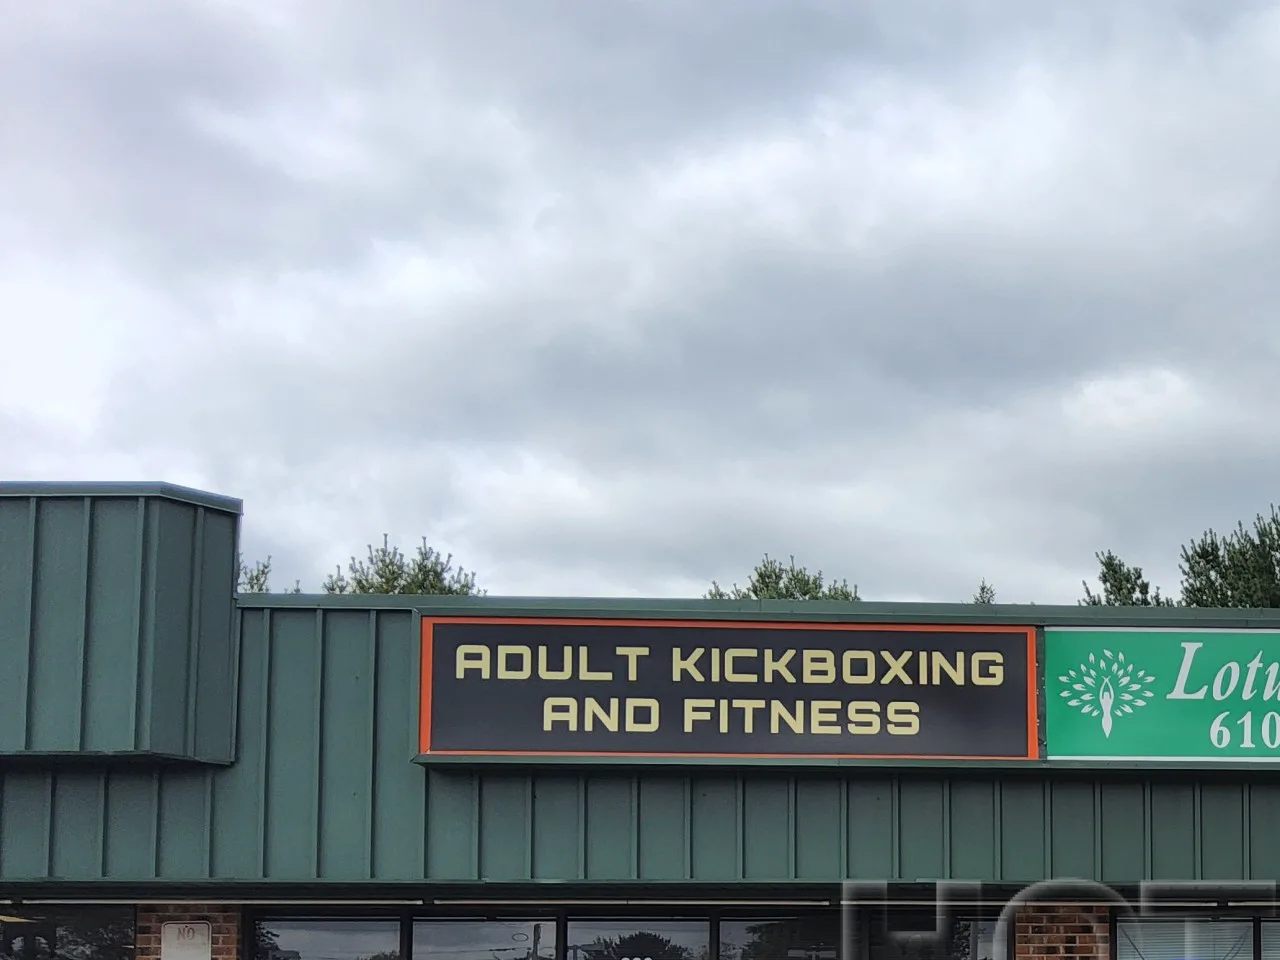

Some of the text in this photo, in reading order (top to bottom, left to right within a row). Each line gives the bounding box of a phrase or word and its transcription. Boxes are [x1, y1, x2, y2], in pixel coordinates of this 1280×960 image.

[455, 644, 1005, 686] ADULT KICKBOXING
[543, 697, 921, 735] AND FITNESS
